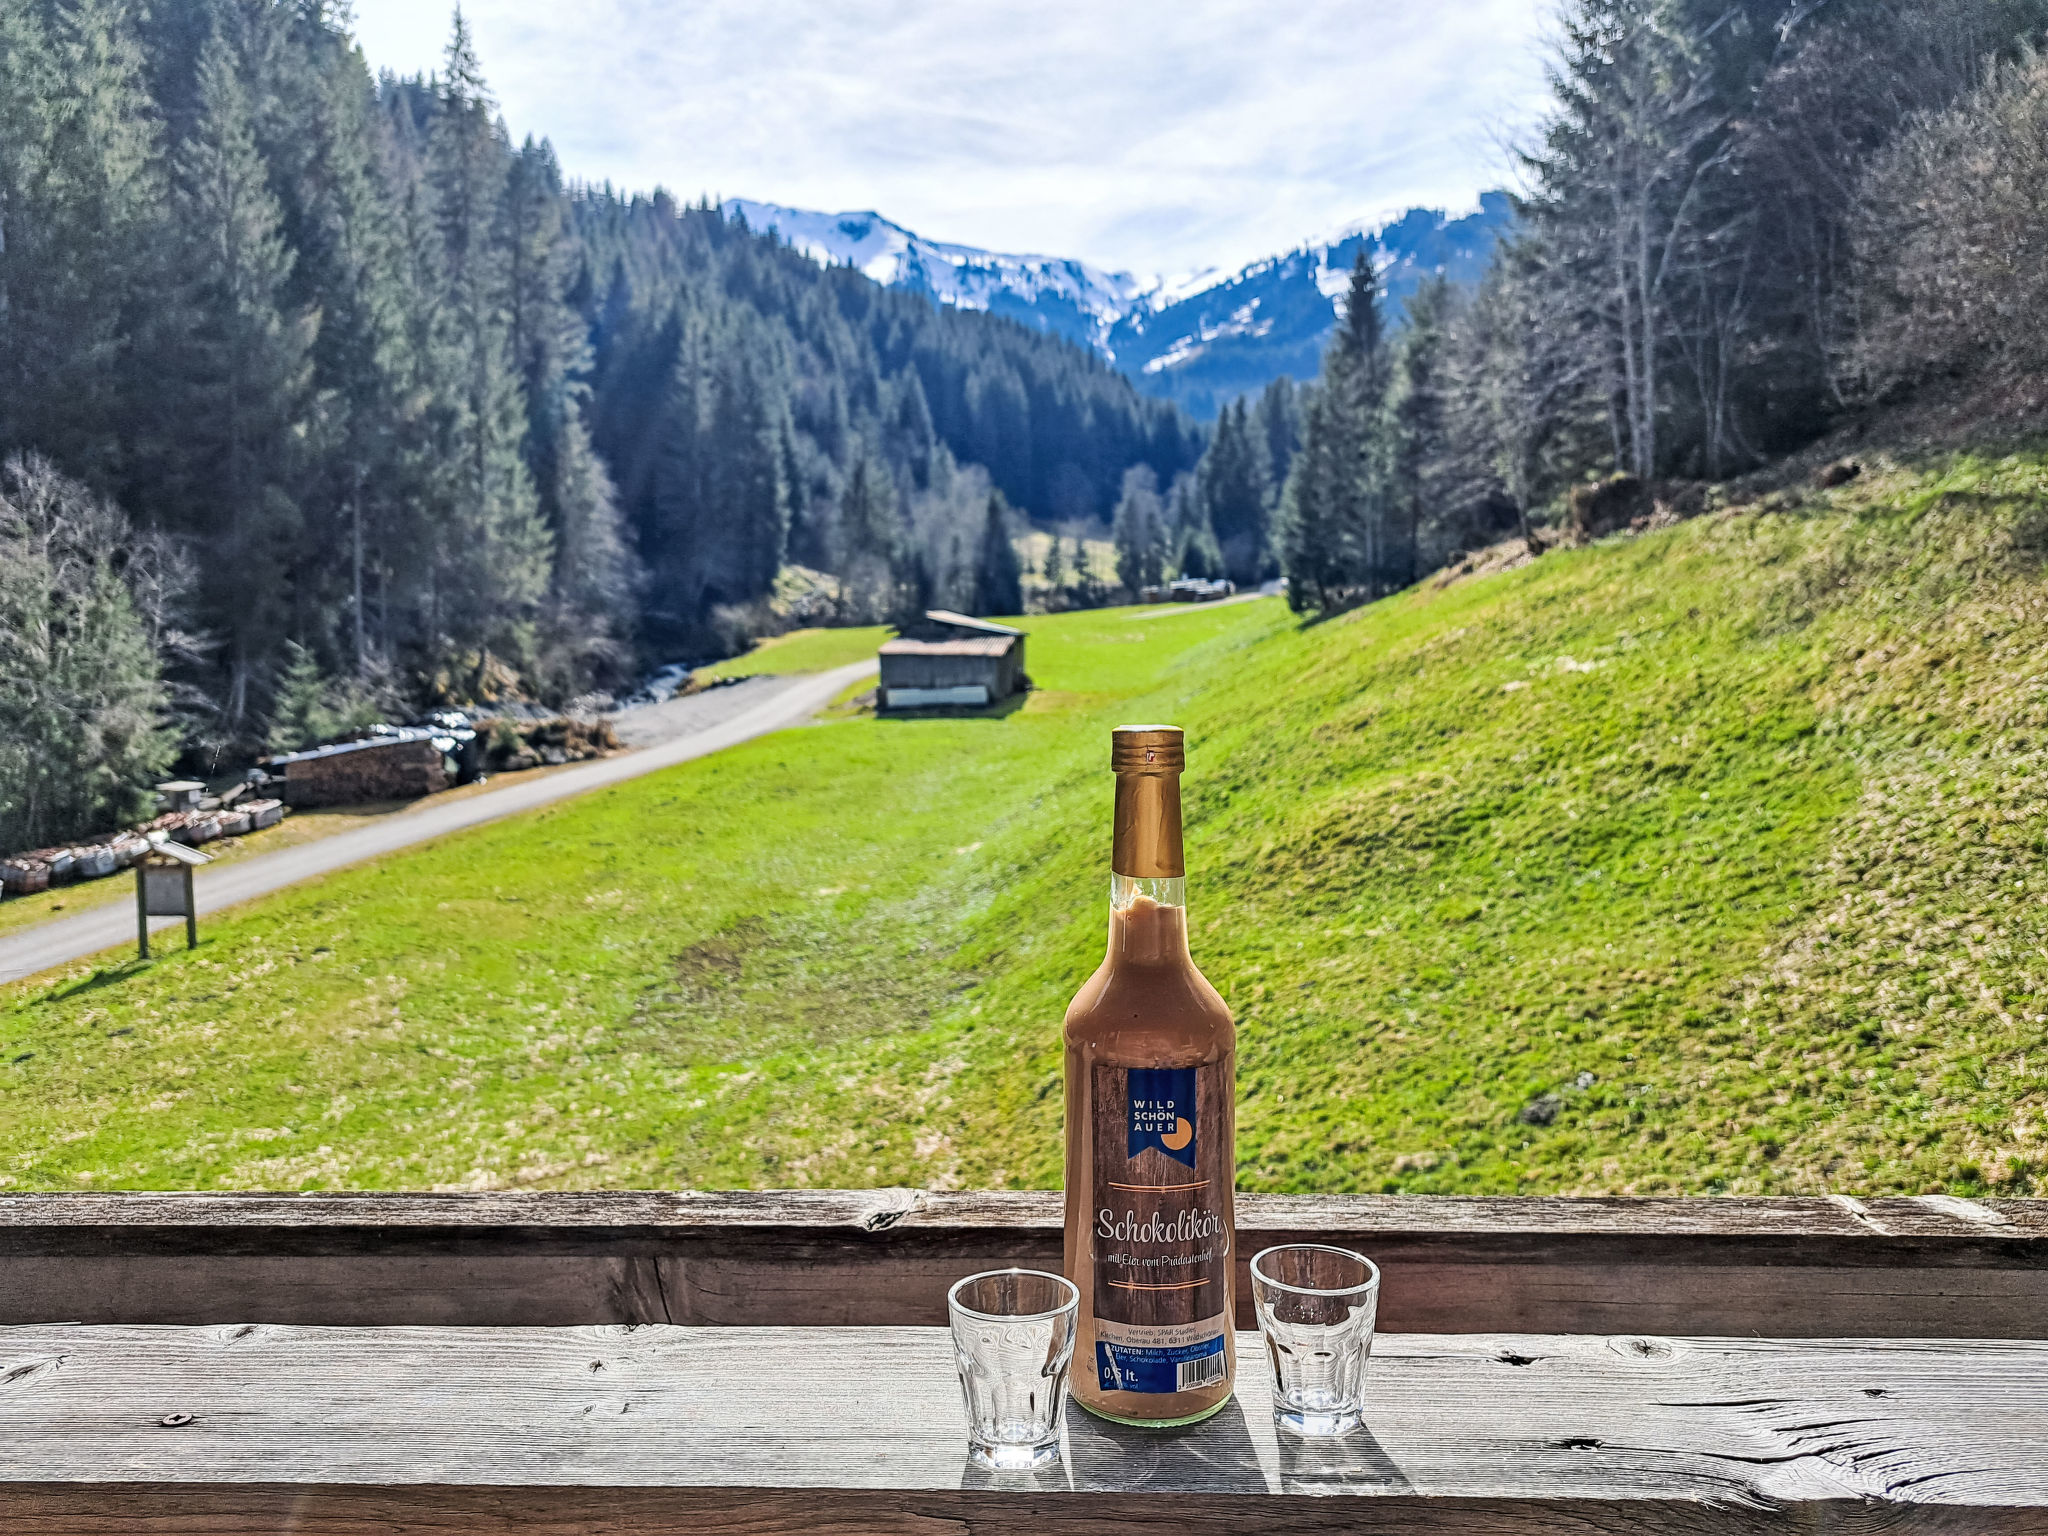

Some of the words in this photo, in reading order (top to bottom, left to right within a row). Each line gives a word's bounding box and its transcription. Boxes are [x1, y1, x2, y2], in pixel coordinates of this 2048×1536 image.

[1134, 1100, 1175, 1109] WILD
[1134, 1110, 1175, 1121] SCHÖN
[1134, 1123, 1175, 1132] AUER
[1097, 1207, 1220, 1244] Schokolikör
[1142, 1258, 1160, 1267] vom
[1111, 1344, 1144, 1355] ZUTATEN:
[1126, 1368, 1139, 1382] lt.
